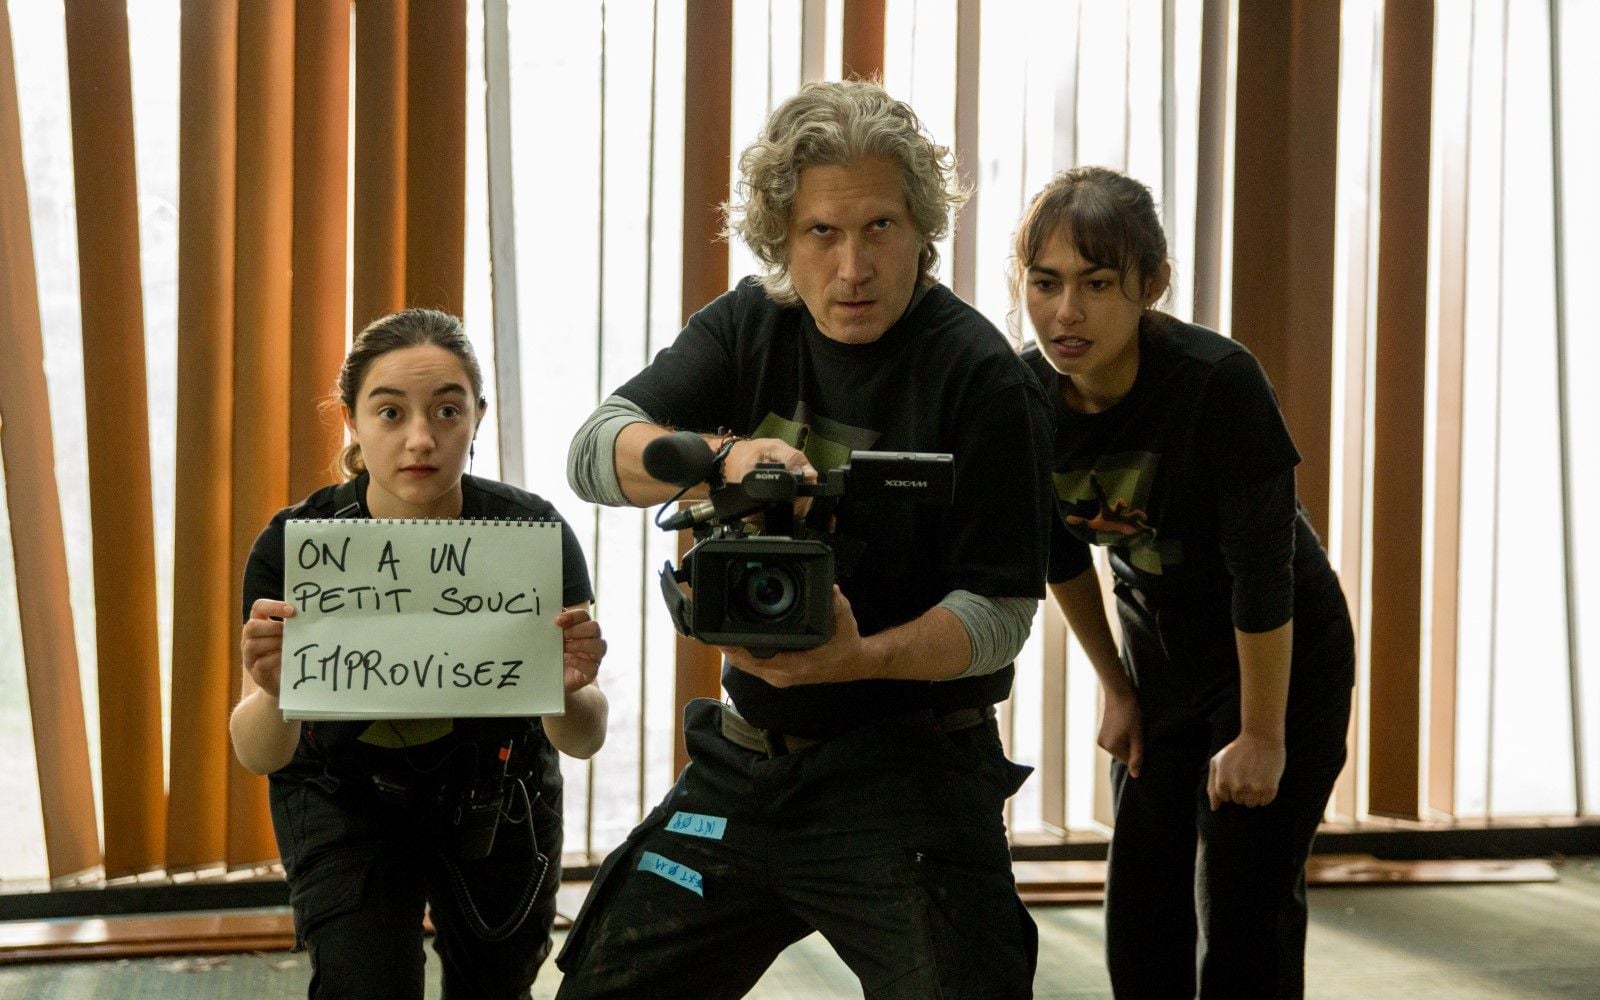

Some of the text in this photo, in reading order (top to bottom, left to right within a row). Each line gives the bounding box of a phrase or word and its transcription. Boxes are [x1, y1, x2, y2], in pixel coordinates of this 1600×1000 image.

[884, 480, 927, 488] XDCAM
[299, 537, 471, 580] ON A UN
